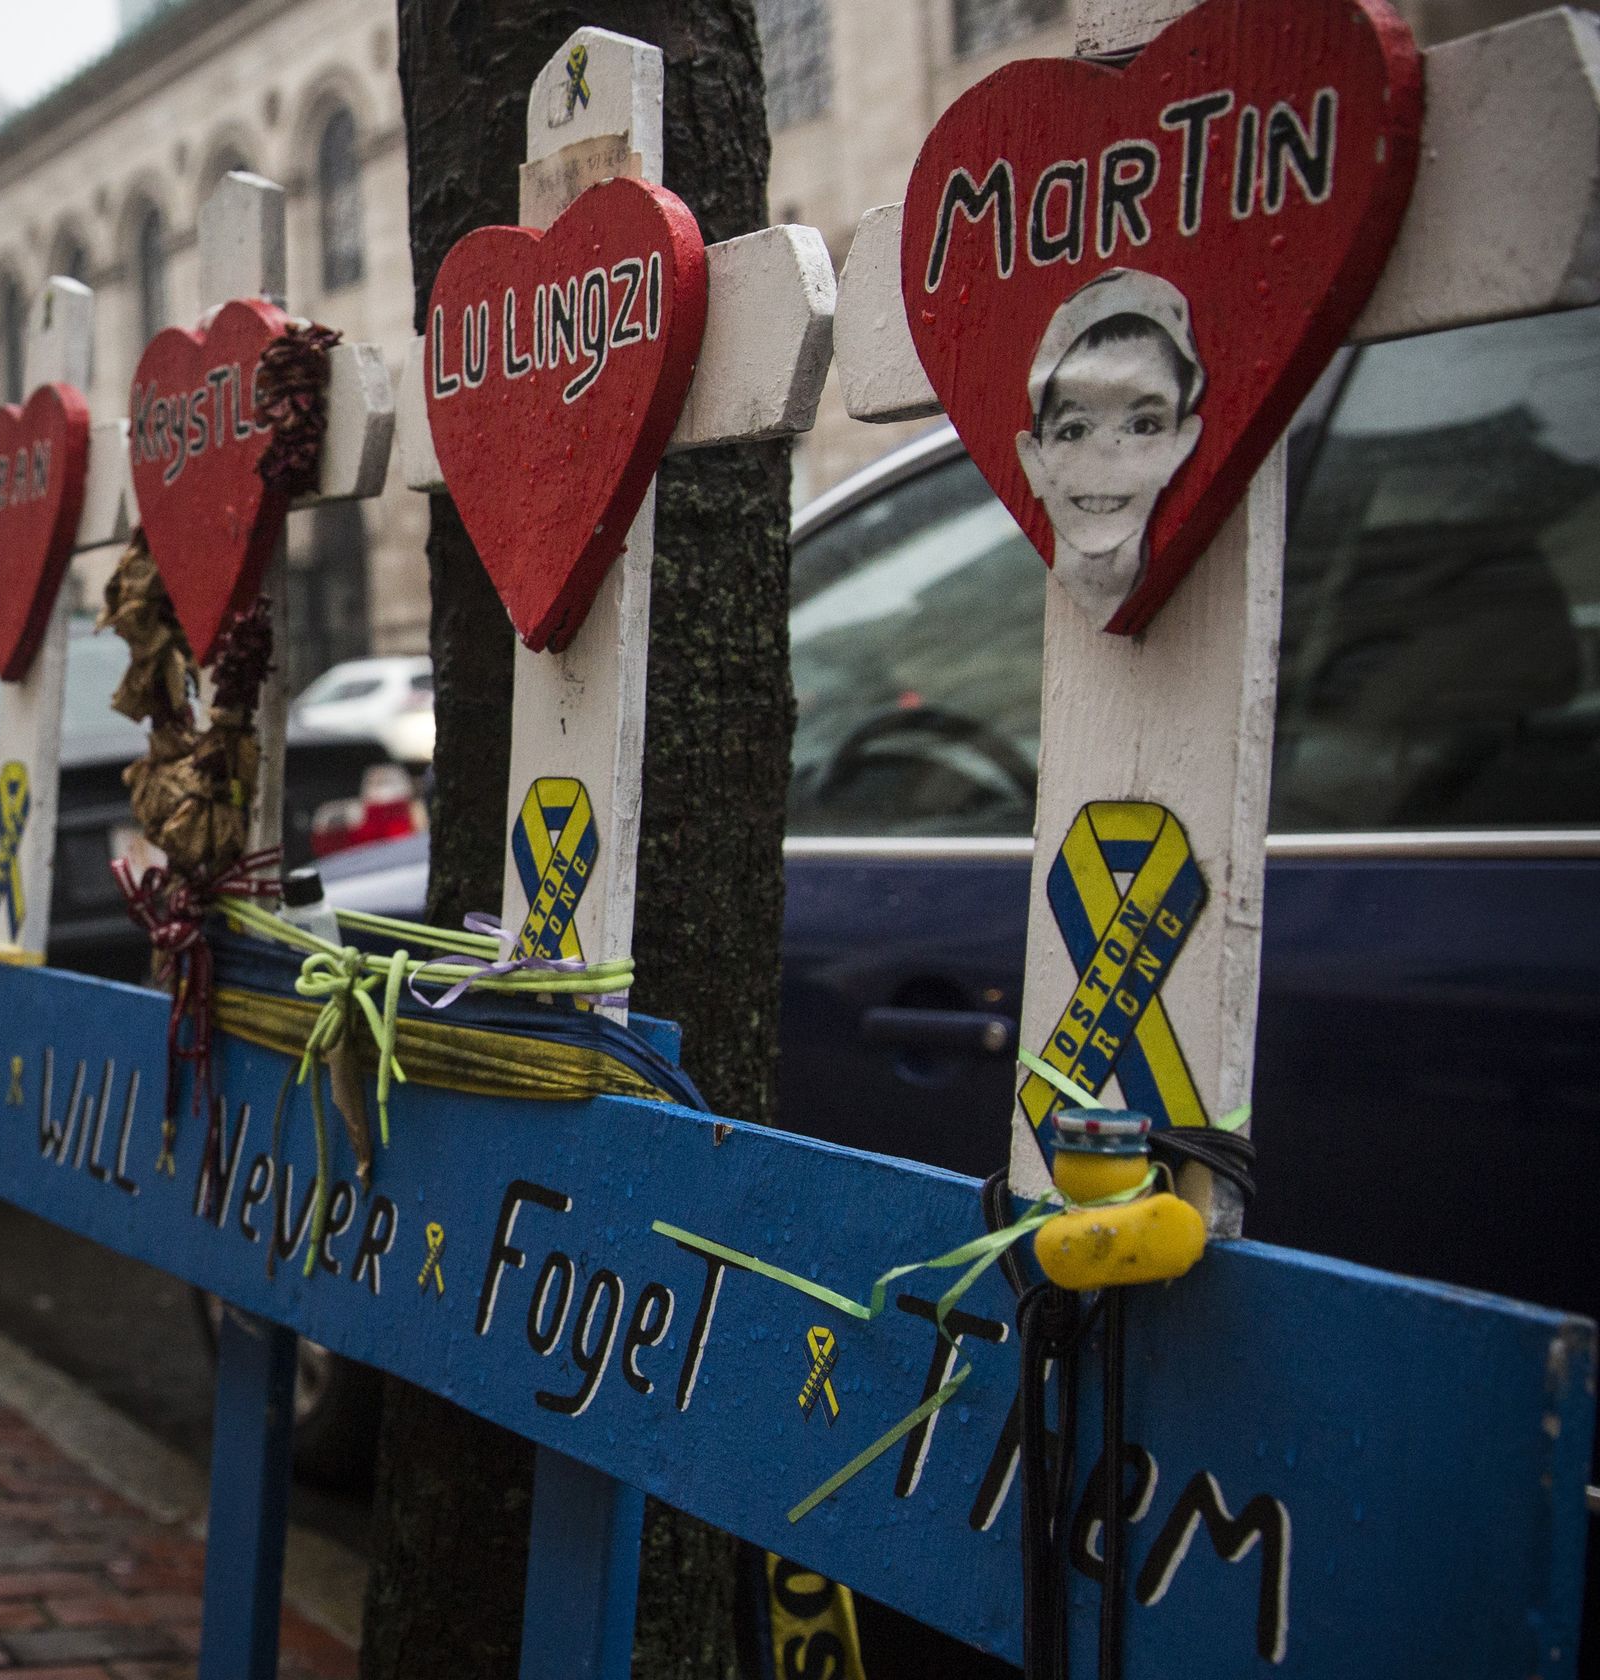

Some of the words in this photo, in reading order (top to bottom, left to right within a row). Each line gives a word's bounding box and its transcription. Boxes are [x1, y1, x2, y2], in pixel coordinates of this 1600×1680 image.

[433, 300, 489, 399] LU
[1044, 899, 1150, 1090] OSTON
[1052, 908, 1184, 1113] TRONG
[40, 1046, 141, 1196] WILL
